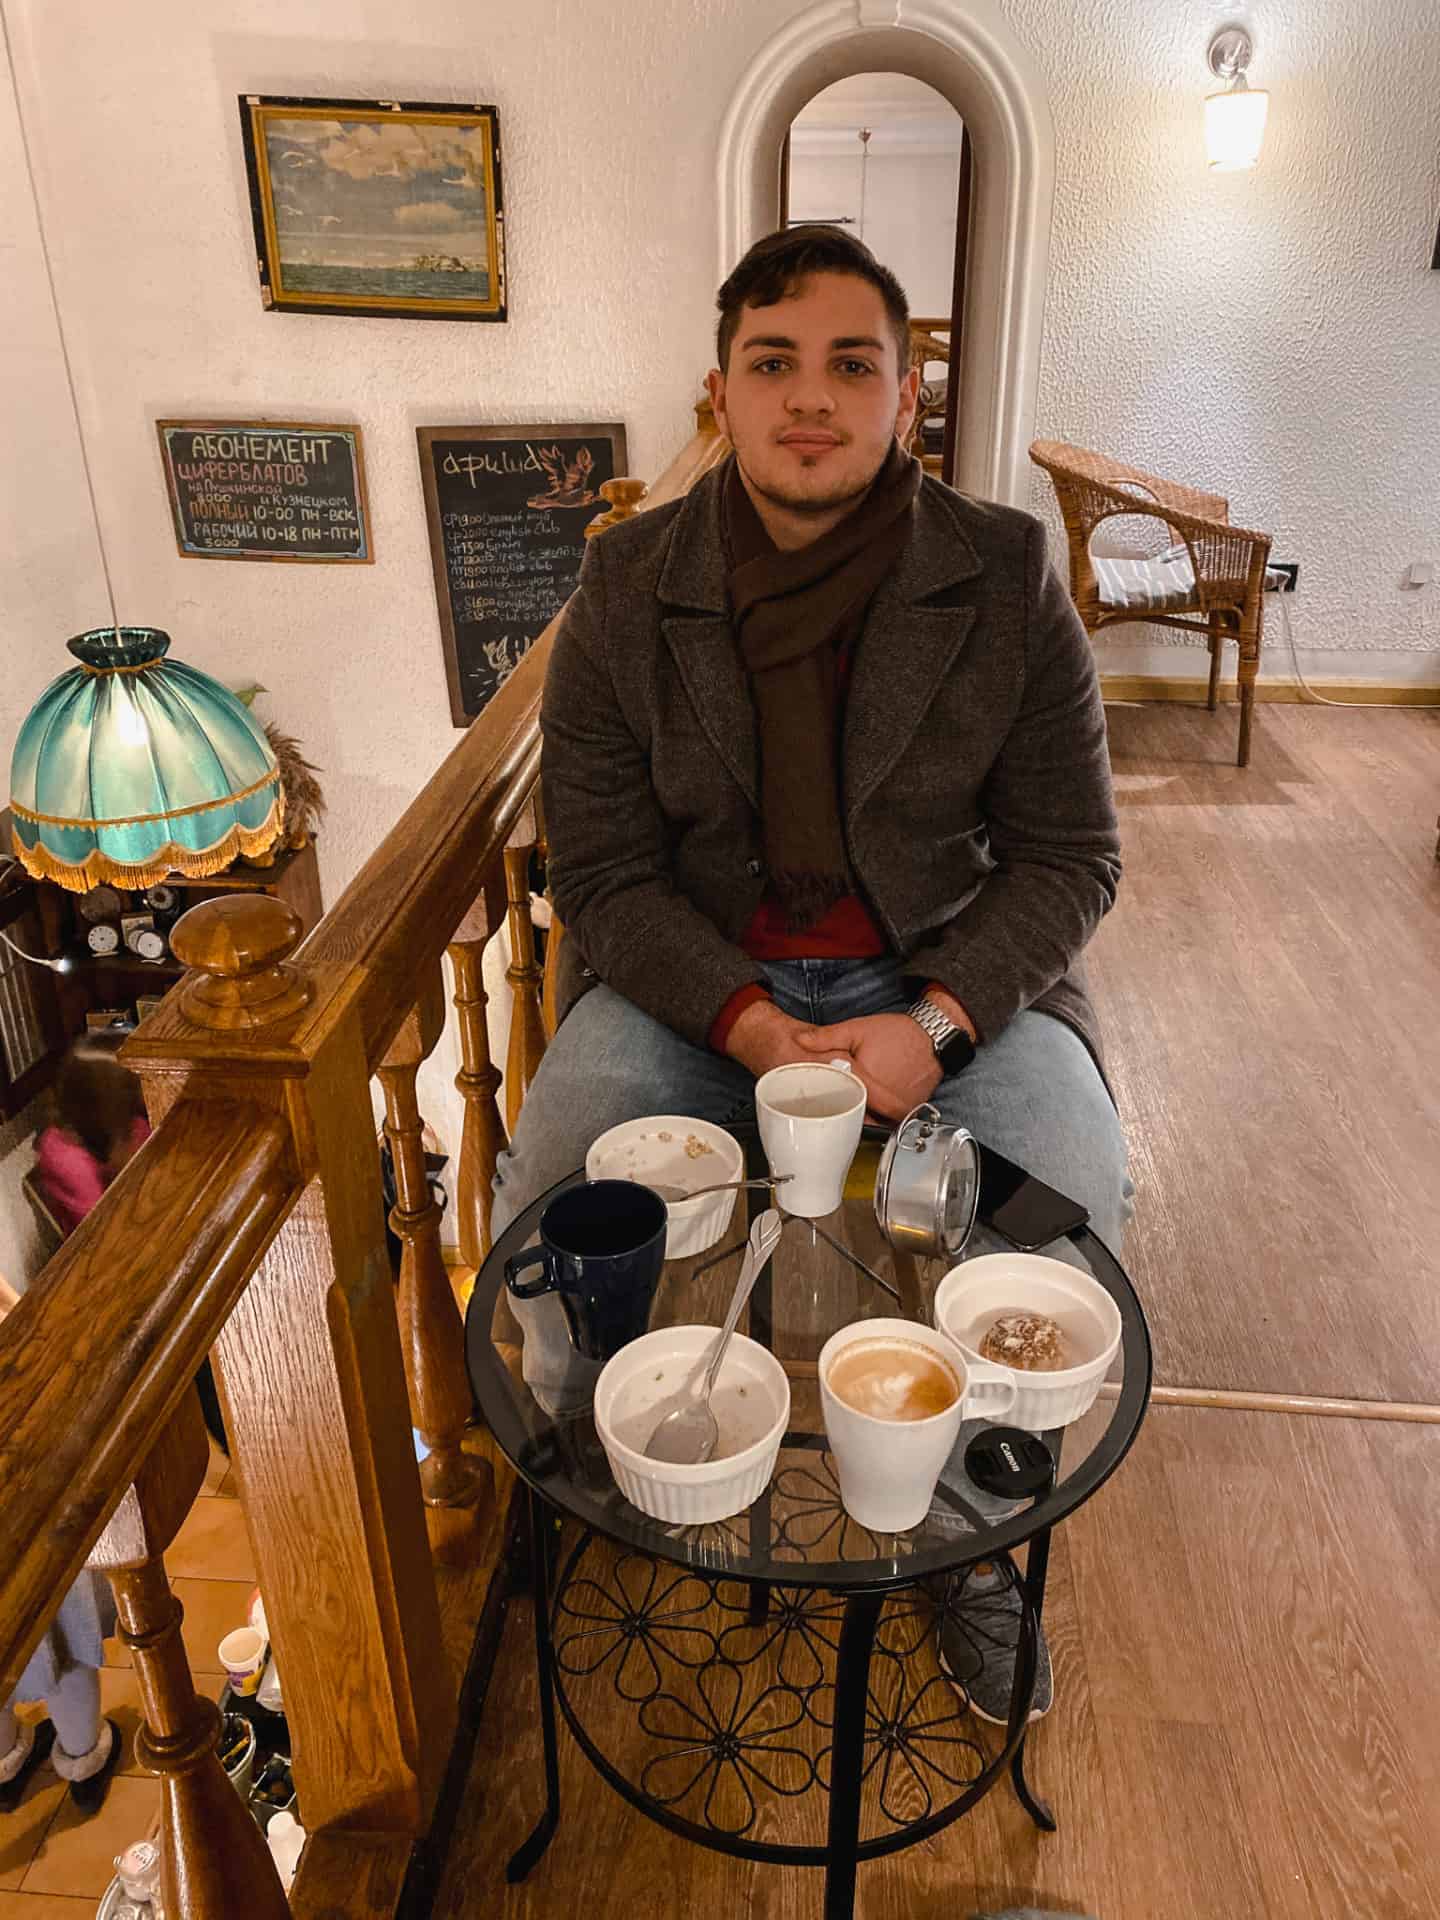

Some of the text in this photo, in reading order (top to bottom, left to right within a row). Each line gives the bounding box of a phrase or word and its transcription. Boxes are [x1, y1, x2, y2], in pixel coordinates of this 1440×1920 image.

[191, 435, 332, 464] АБОНЕМЕНТ
[177, 462, 308, 486] ЦИФЕРБЛАТОВ
[193, 520, 258, 539] РАБОЧИЙ
[1000, 1442, 1021, 1472] Canon
